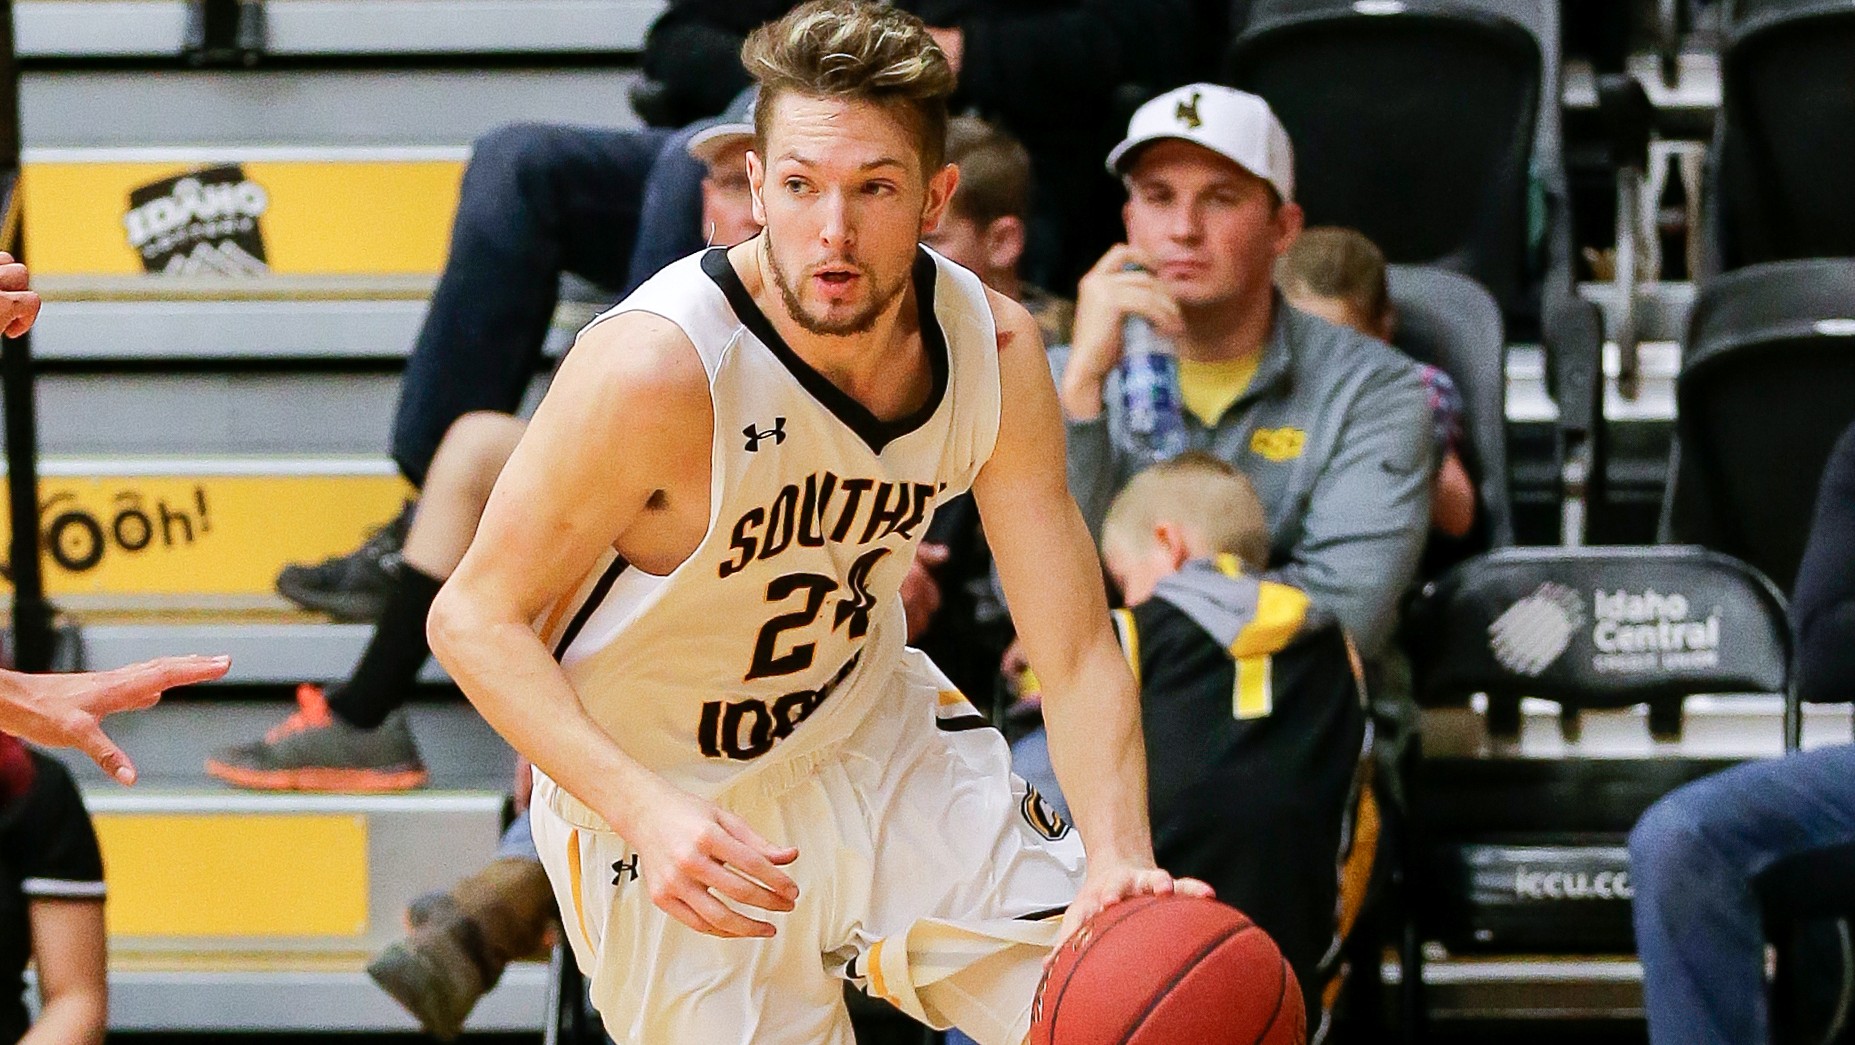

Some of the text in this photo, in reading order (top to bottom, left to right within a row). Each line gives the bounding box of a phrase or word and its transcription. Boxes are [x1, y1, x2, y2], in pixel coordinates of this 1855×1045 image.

[718, 470, 948, 579] SOUTHE
[741, 547, 892, 682] 24
[1593, 615, 1720, 652] Central
[1594, 588, 1688, 621] Idaho
